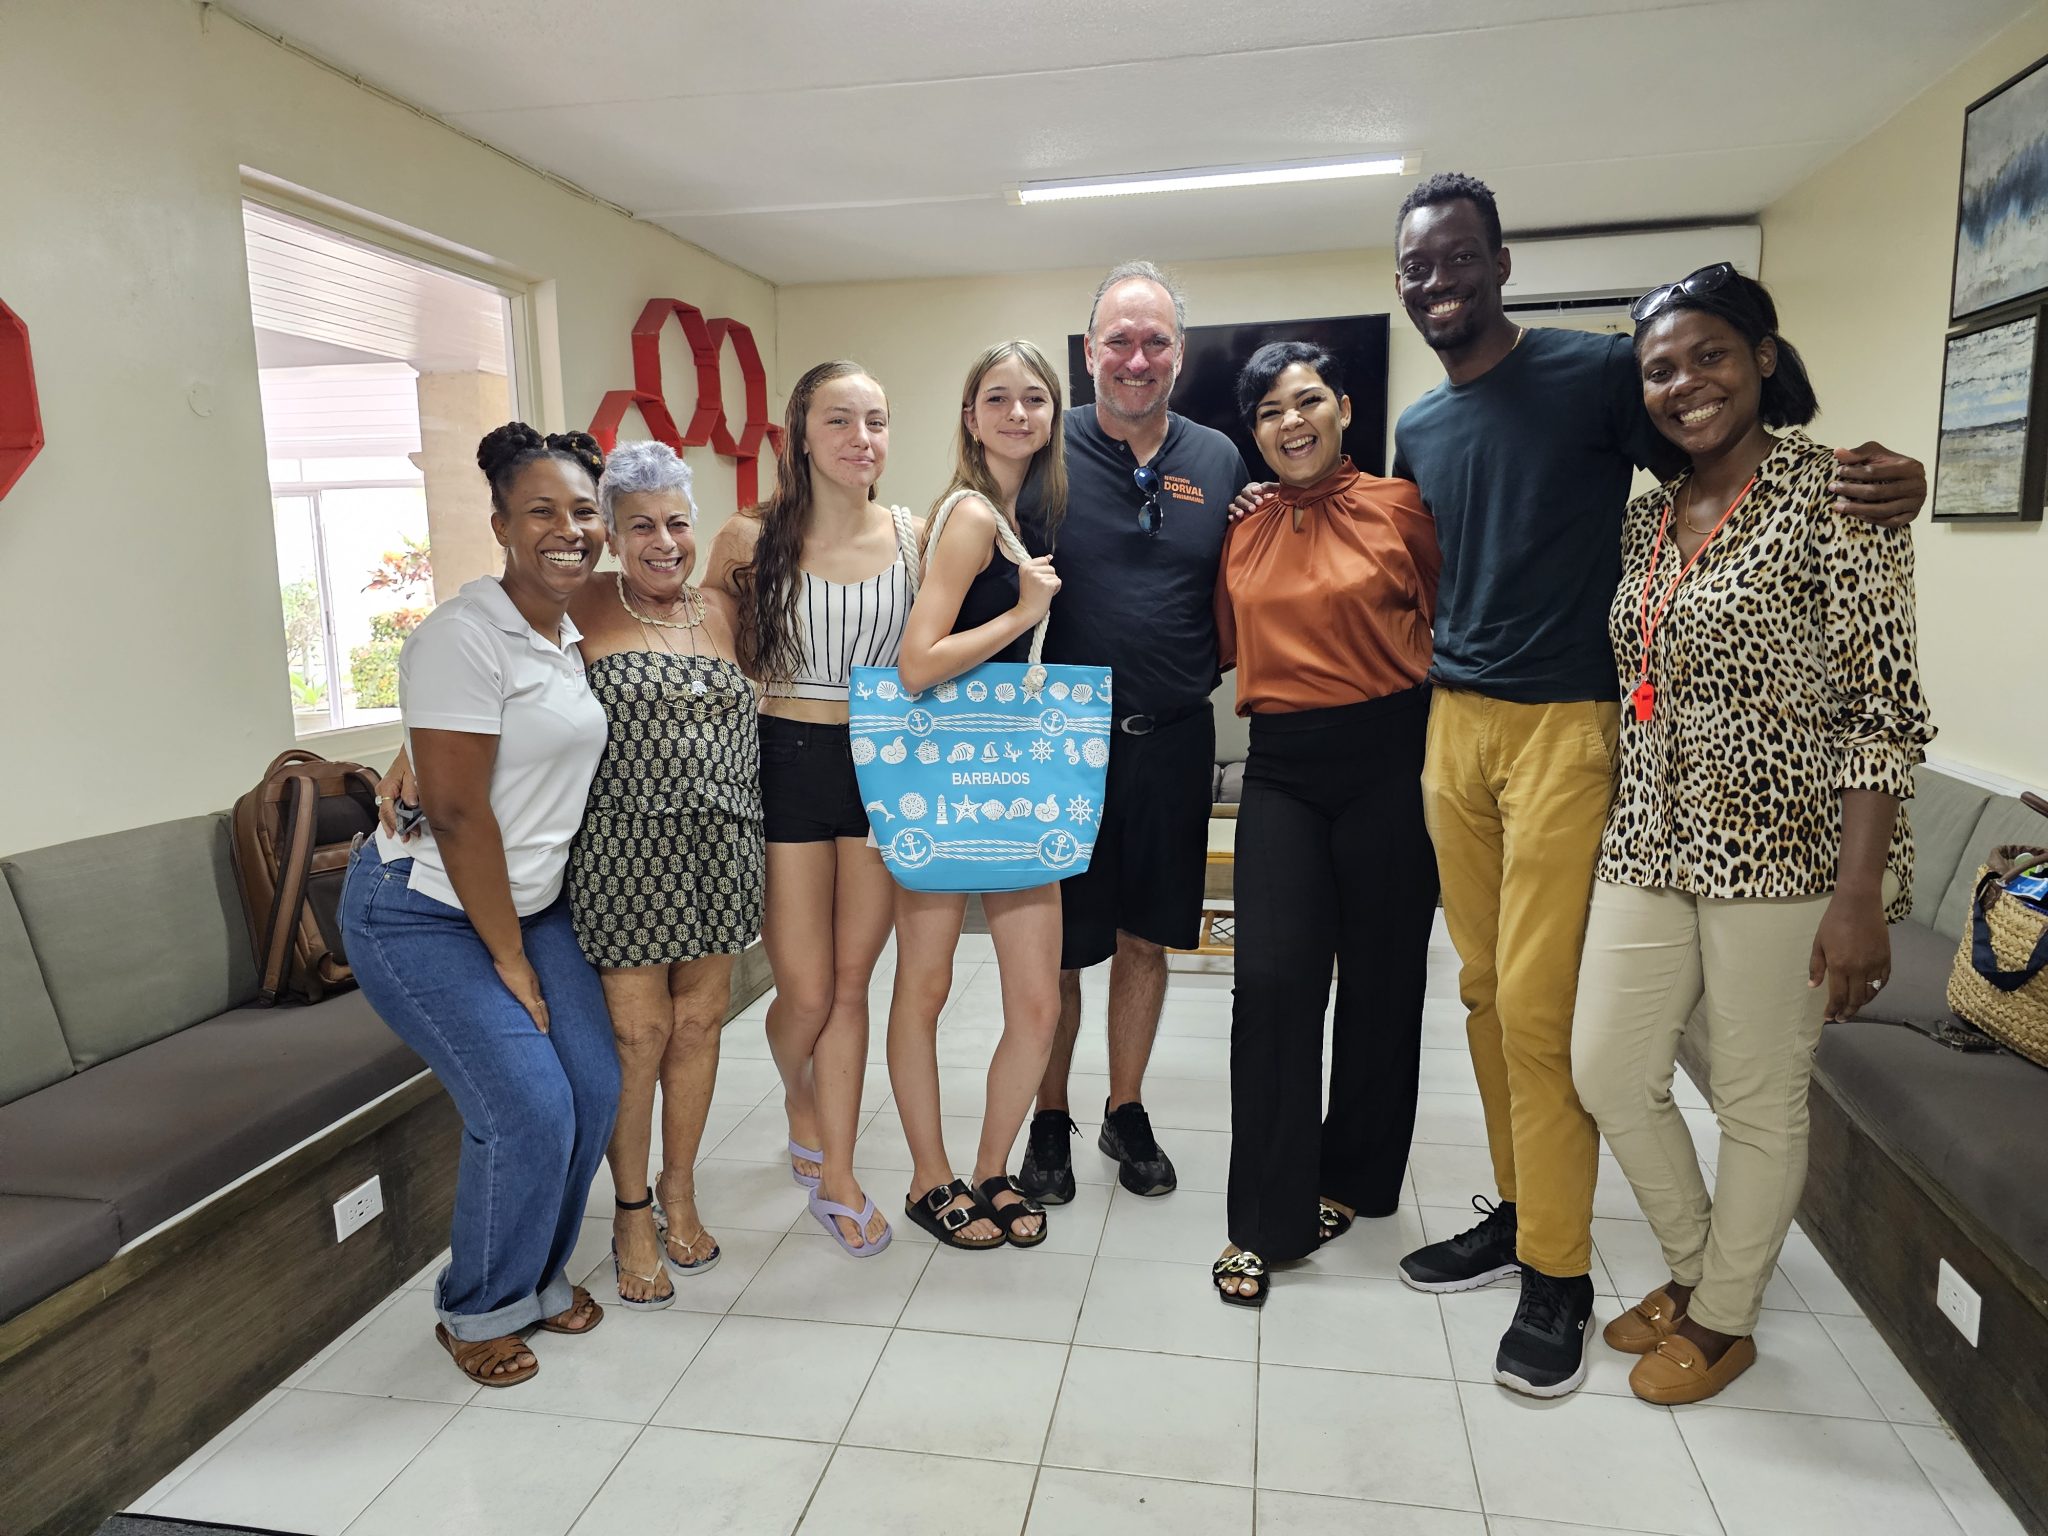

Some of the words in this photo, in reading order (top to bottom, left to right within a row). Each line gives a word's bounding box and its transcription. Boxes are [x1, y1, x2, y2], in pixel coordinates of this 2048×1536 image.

[1164, 481, 1204, 497] DORVAL
[1172, 492, 1205, 505] SWIMMING
[952, 771, 1031, 785] BARBADOS
